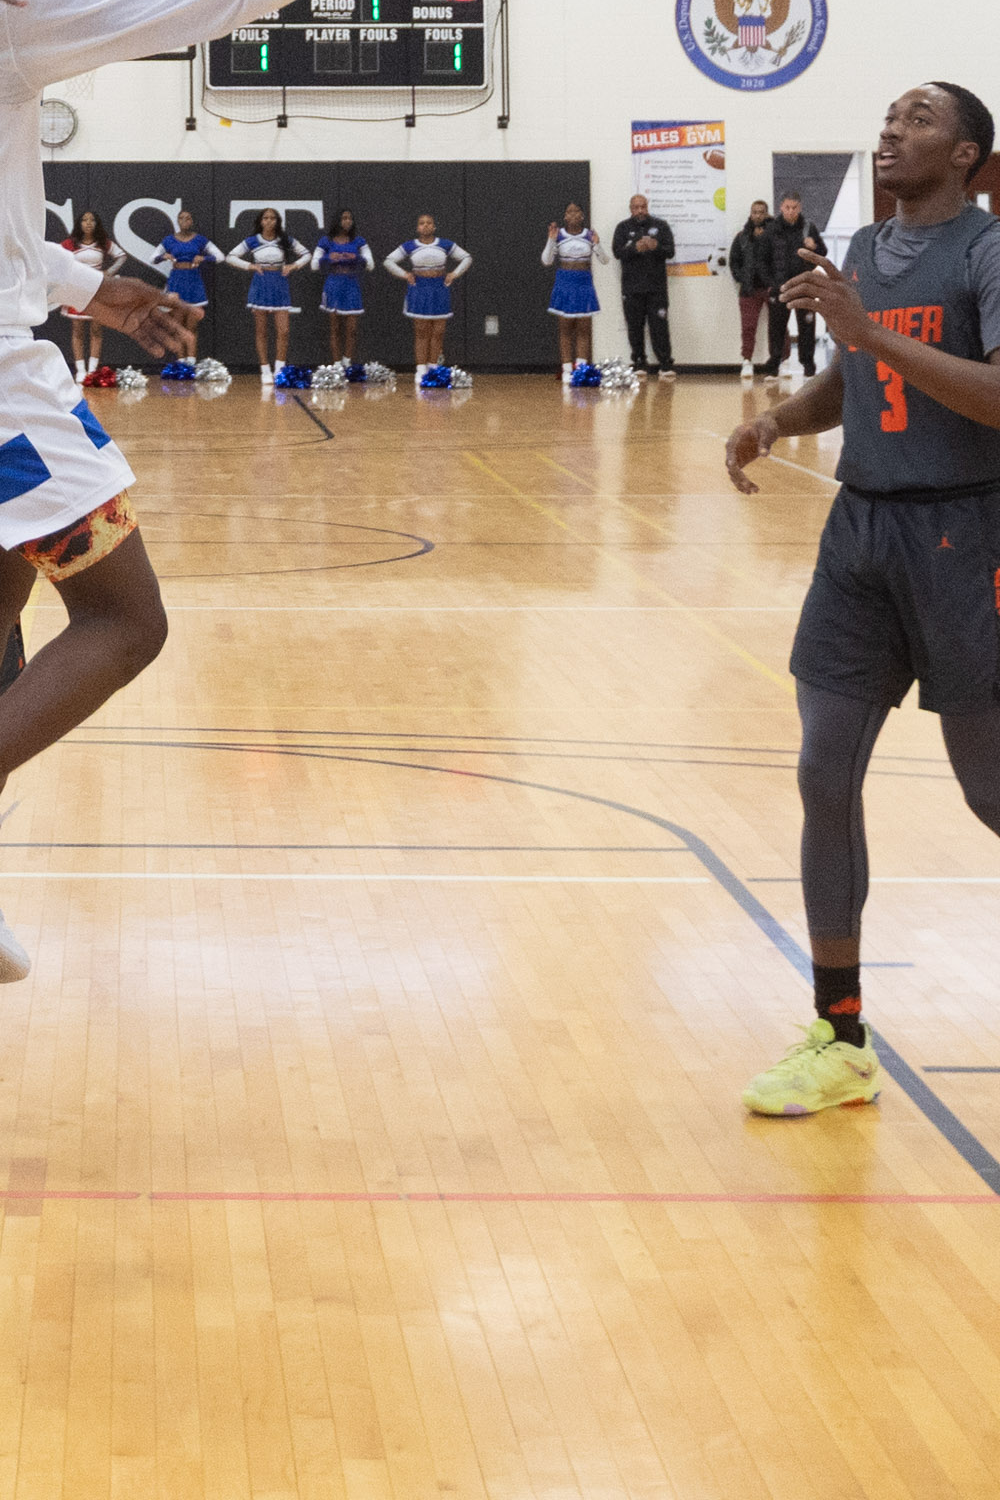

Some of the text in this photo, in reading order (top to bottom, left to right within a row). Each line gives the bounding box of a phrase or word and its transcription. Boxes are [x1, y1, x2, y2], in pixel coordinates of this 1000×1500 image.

[412, 7, 453, 19] BONUS
[231, 28, 270, 41] FOULS
[305, 29, 398, 41] PLAYER FOULS
[424, 28, 463, 41] FOULS
[260, 43, 268, 71] 1
[454, 43, 462, 71] 1
[740, 79, 765, 88] 2020
[632, 129, 721, 147] RULES GYM
[876, 360, 908, 432] 3
